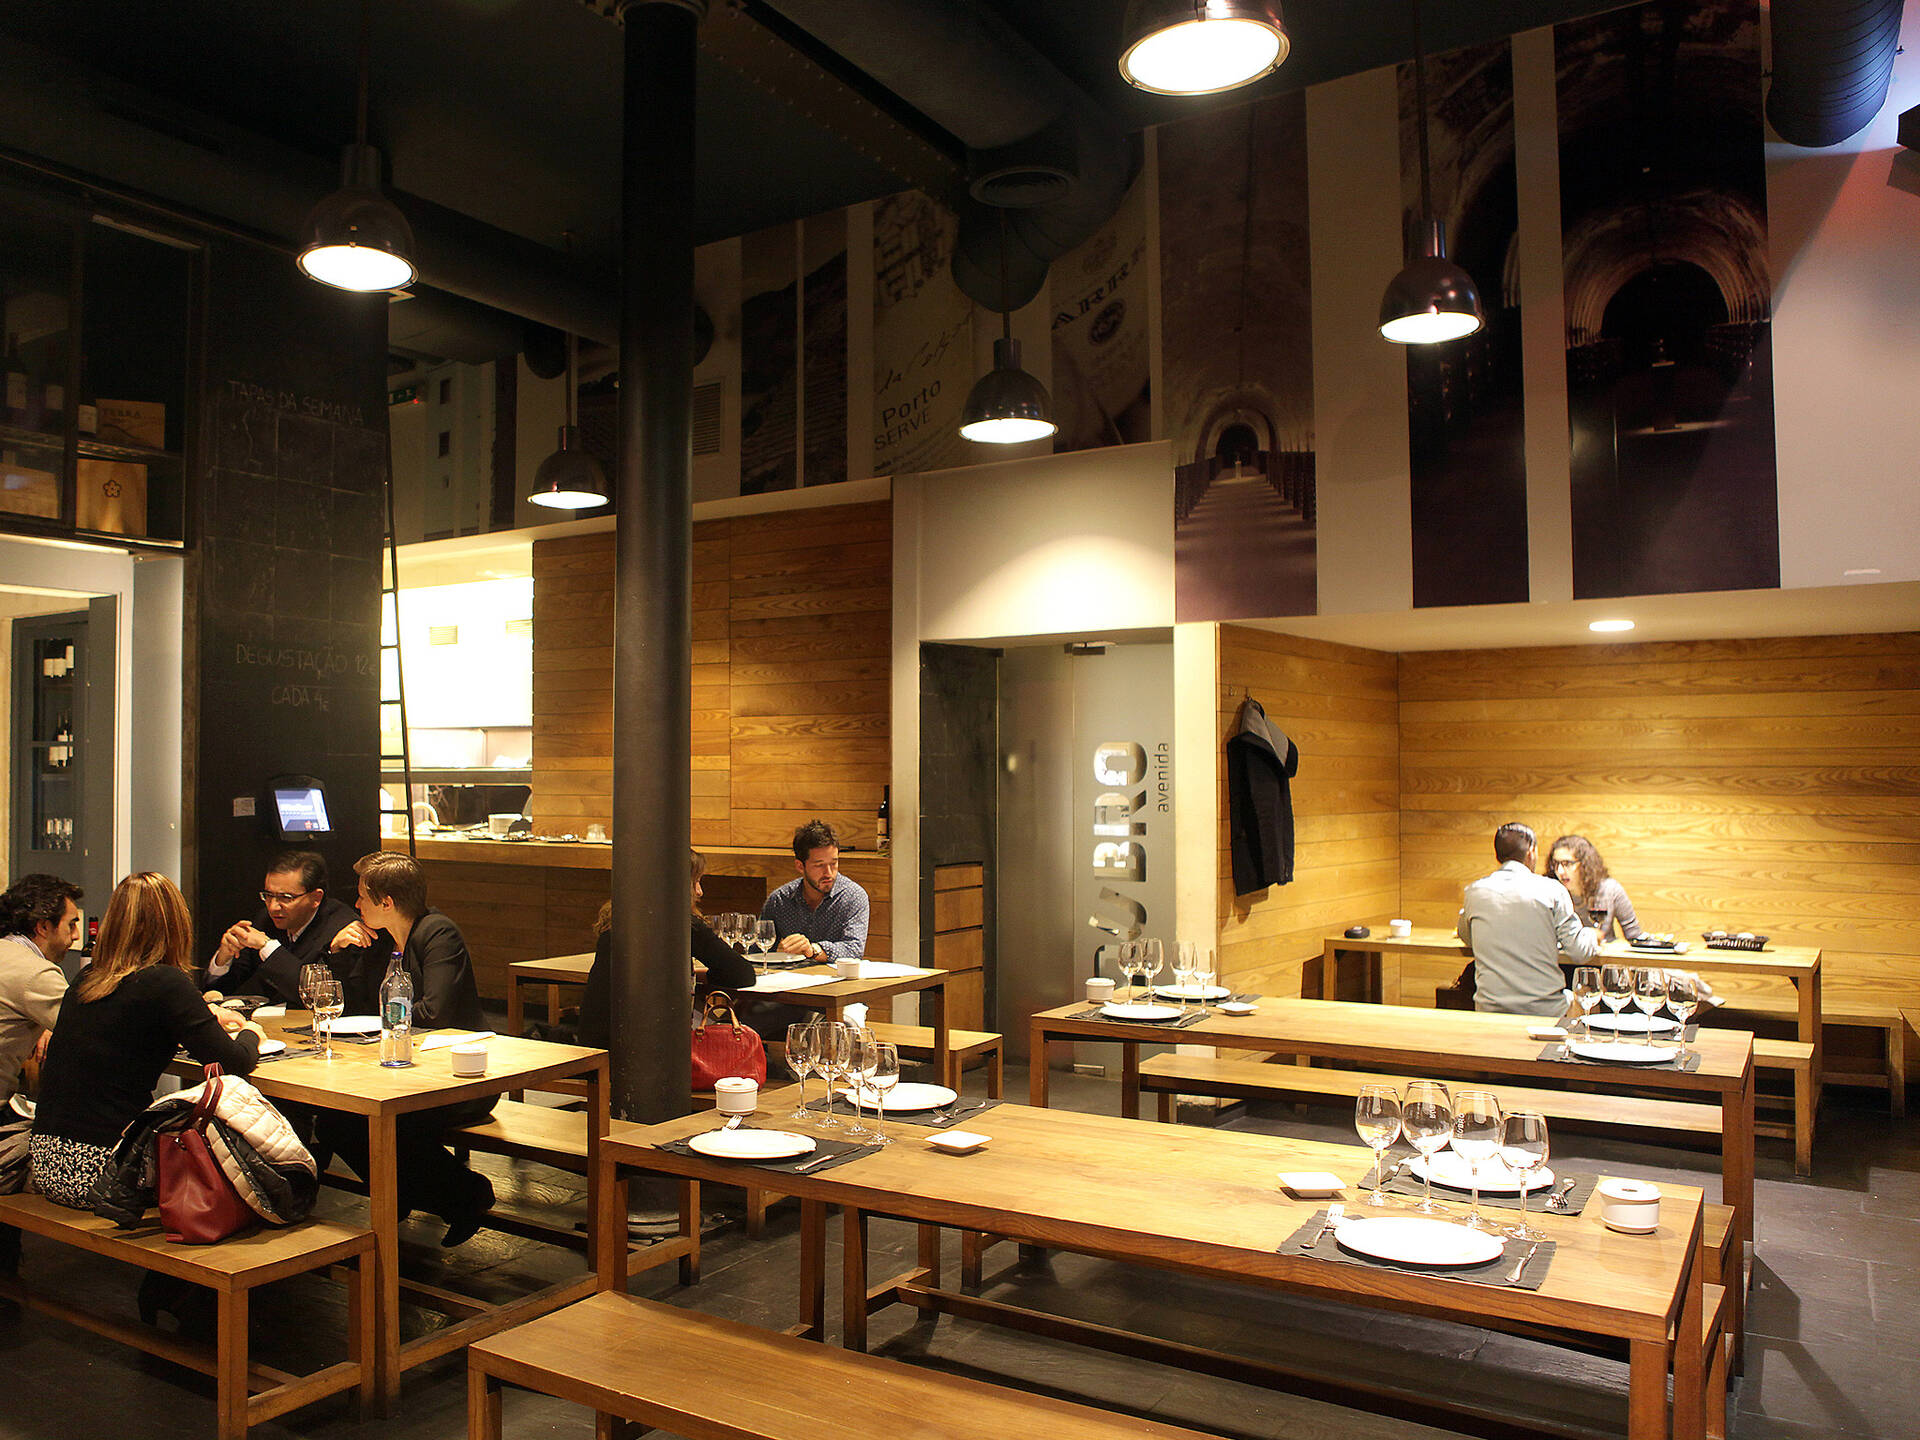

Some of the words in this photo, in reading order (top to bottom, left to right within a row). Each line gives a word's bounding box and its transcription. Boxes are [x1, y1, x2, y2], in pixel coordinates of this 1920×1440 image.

[881, 379, 941, 428] Porto
[873, 408, 930, 451] SERVE
[236, 643, 348, 680] DEGUSTAÇÃO
[271, 687, 310, 707] CADA
[1154, 742, 1169, 813] avenida
